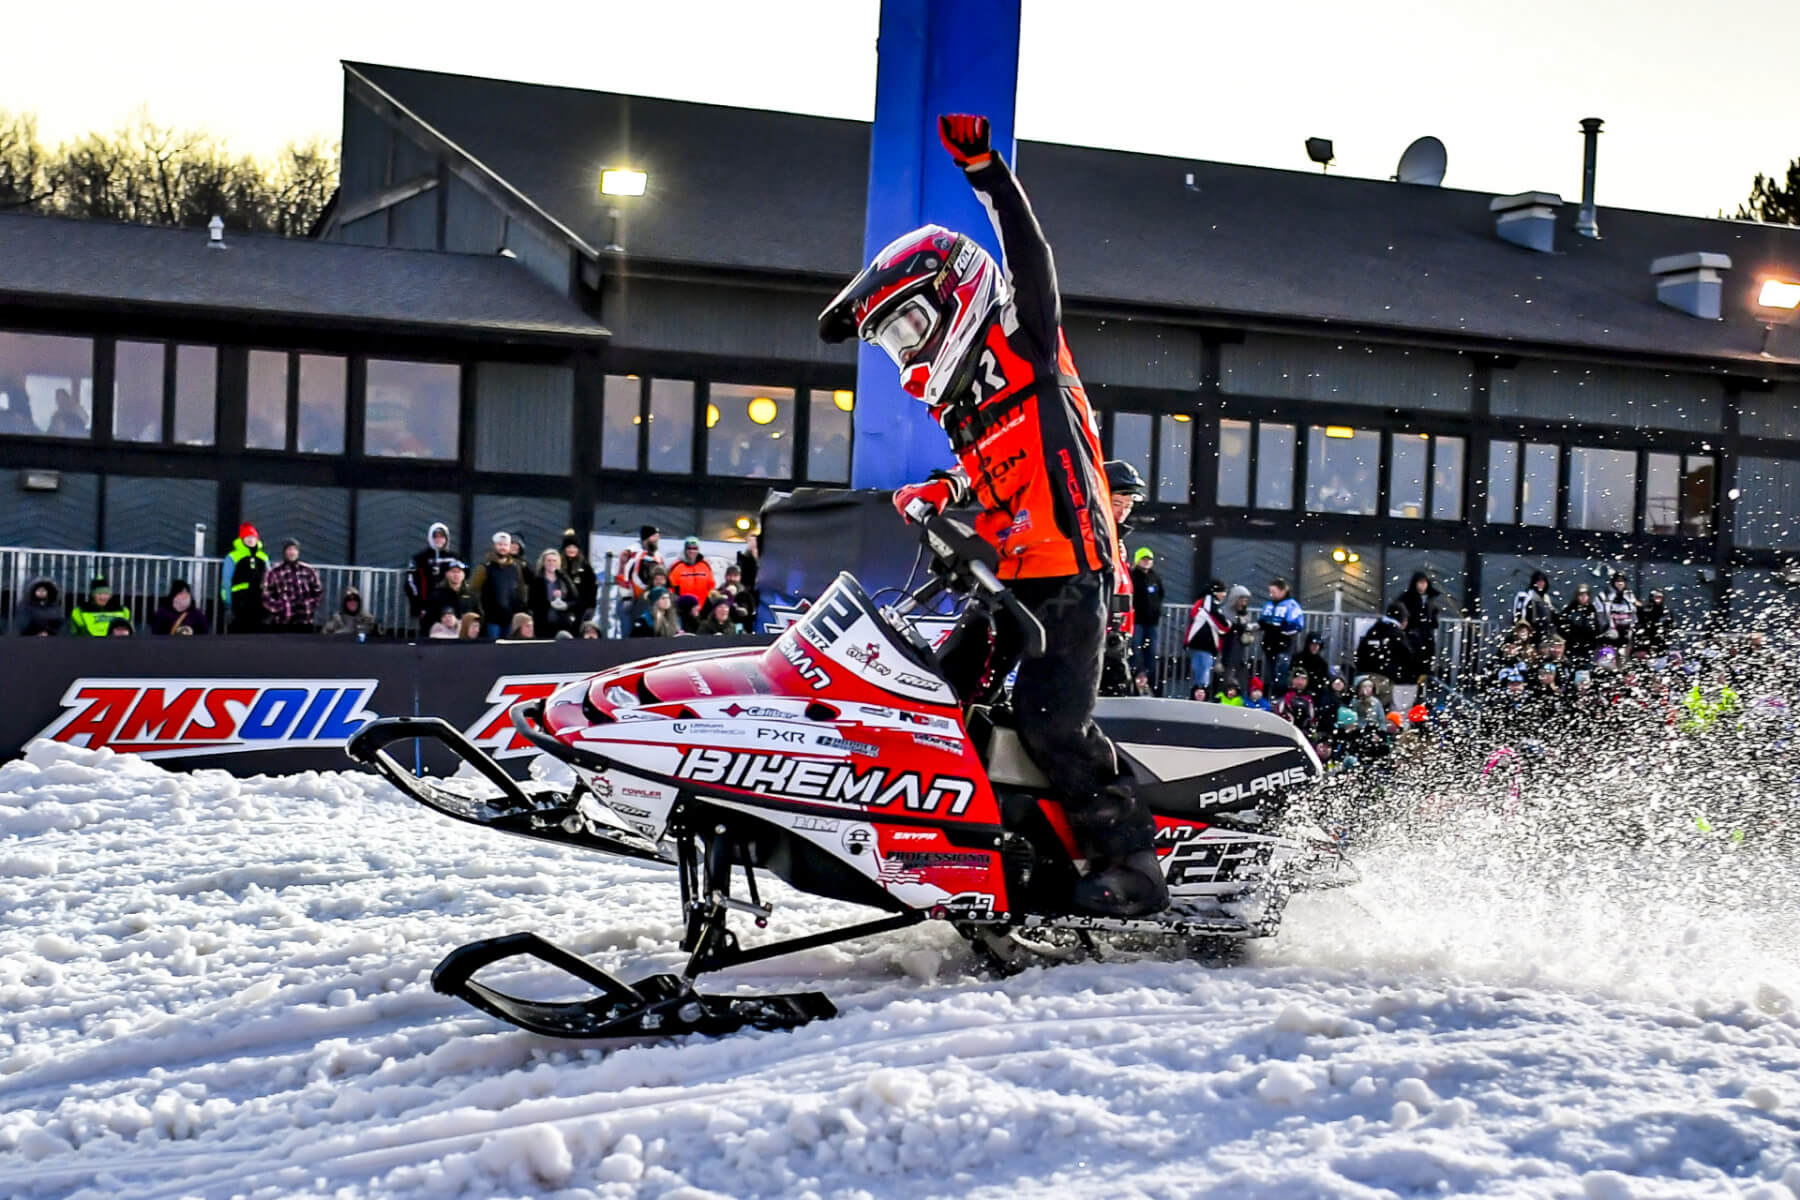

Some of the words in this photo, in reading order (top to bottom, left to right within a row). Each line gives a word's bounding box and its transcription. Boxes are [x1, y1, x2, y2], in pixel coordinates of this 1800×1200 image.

[52, 686, 378, 753] AMSOIL
[757, 728, 806, 744] FXR
[678, 748, 975, 815] BIKEMAN
[1199, 766, 1307, 808] POLARIS
